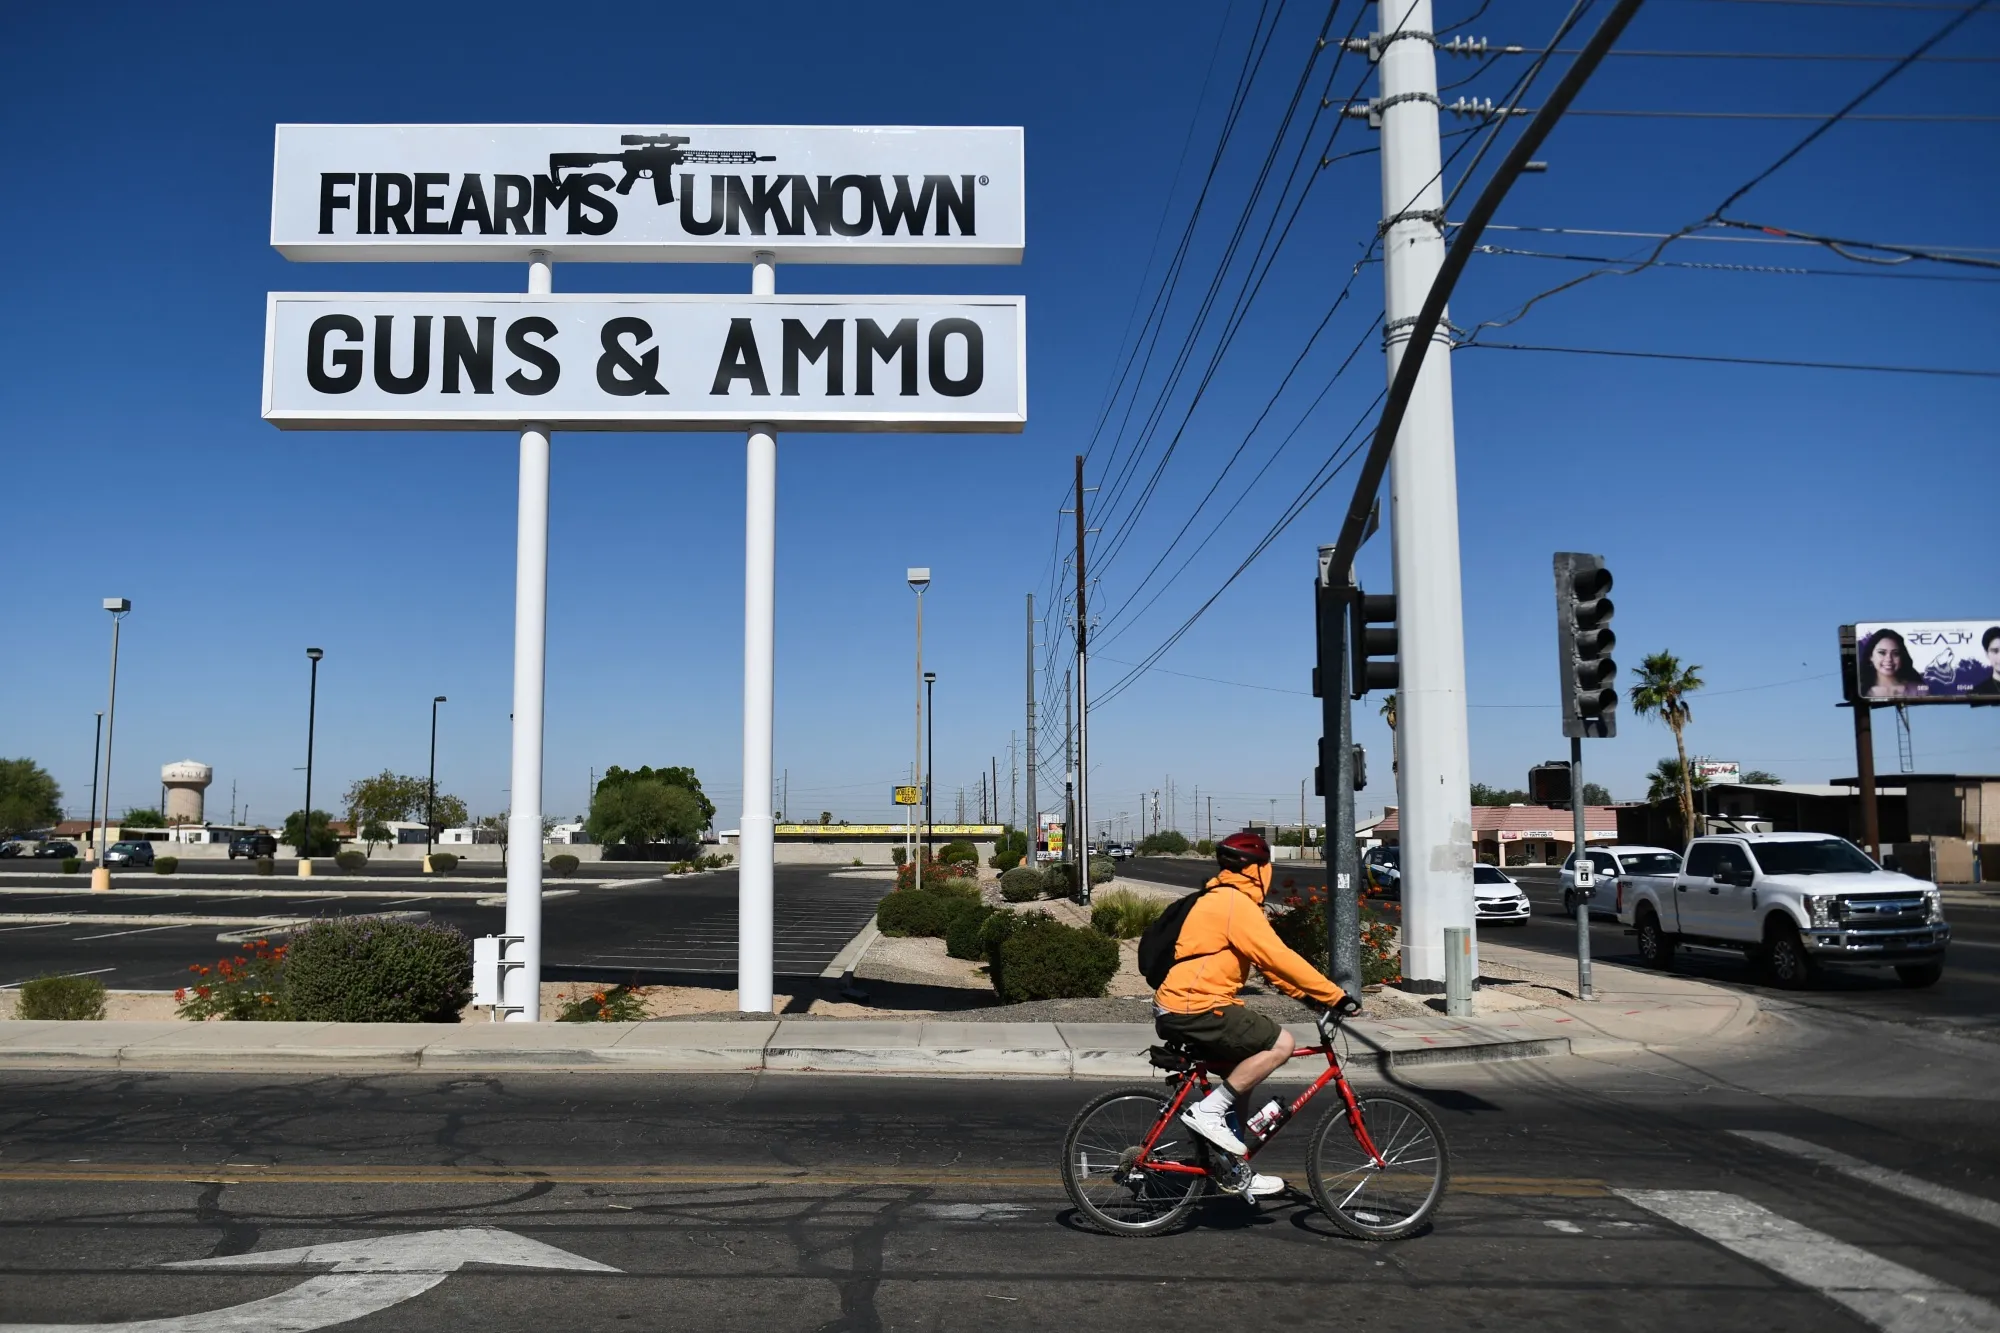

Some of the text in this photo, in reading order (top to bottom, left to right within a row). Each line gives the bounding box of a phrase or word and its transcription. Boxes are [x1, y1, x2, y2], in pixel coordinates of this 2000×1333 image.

[317, 173, 618, 236] FIREARMS
[306, 314, 985, 397] GUNS & AMMO
[1907, 632, 1973, 645] READY
[896, 788, 910, 796] MOBILE
